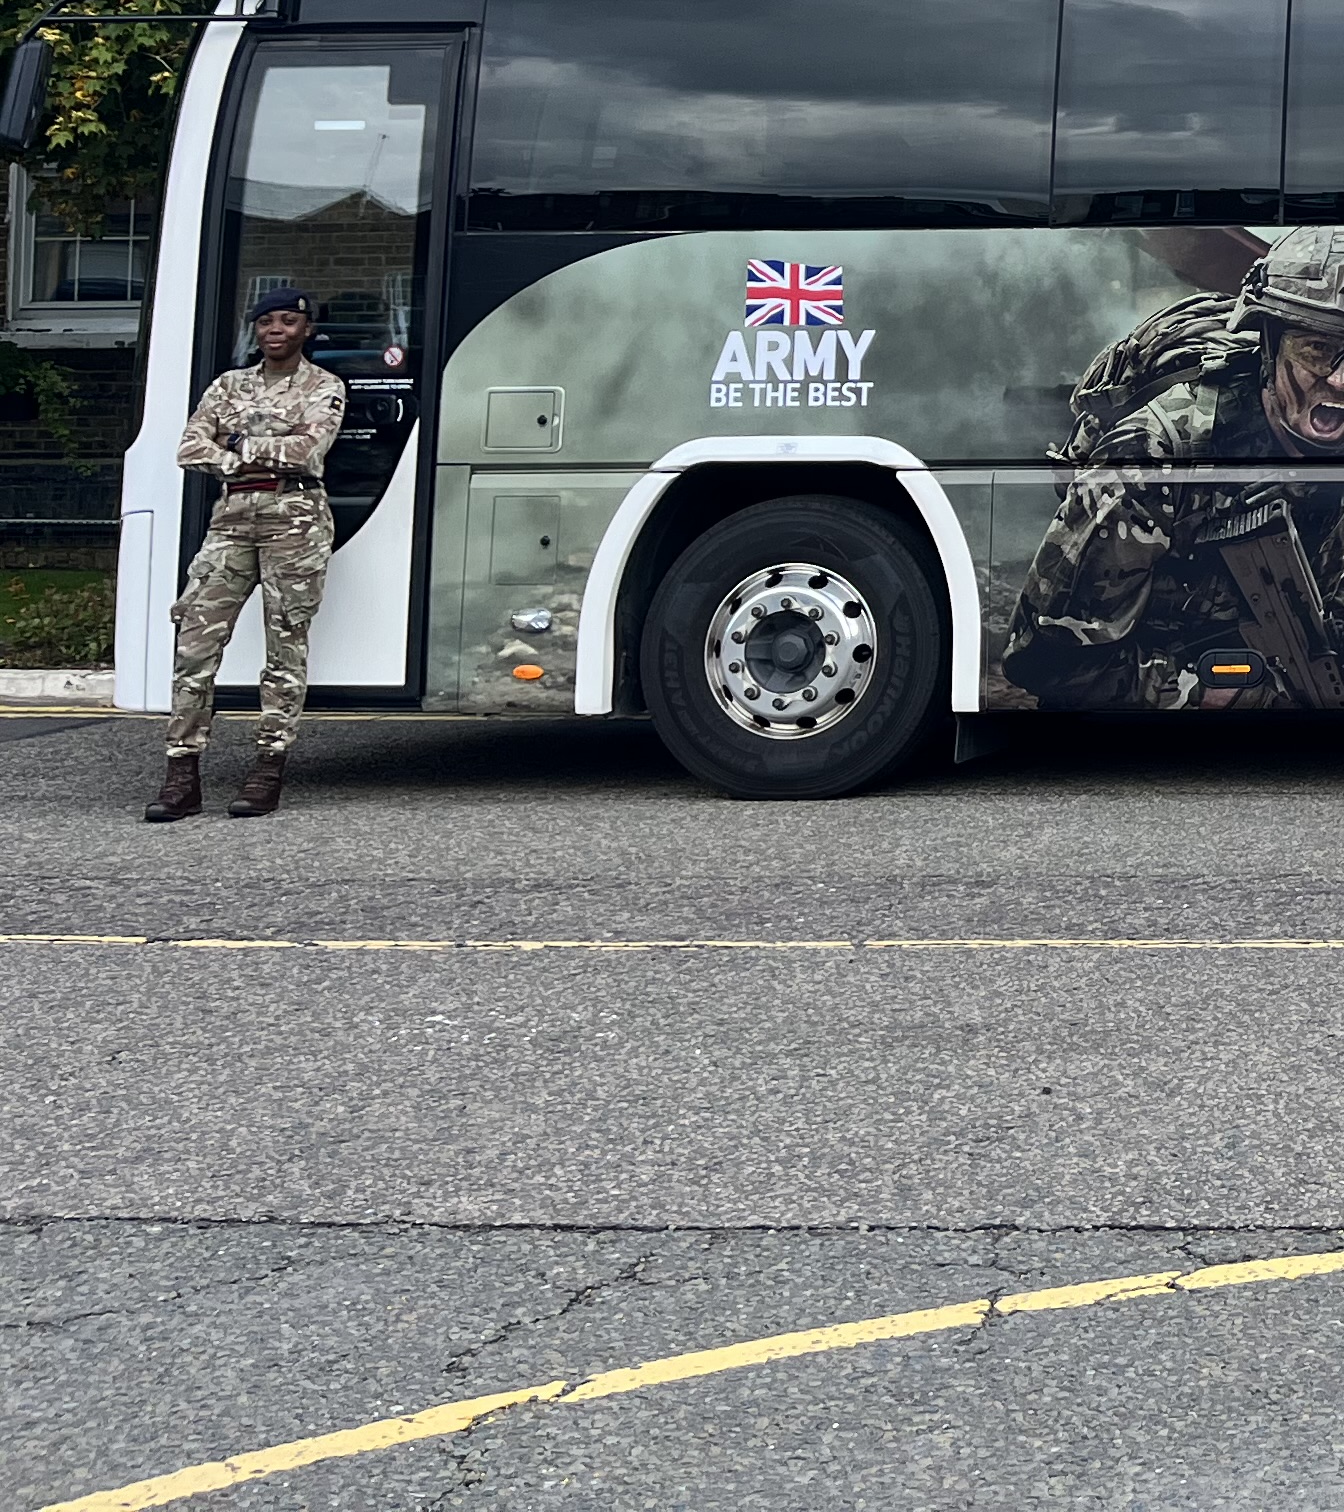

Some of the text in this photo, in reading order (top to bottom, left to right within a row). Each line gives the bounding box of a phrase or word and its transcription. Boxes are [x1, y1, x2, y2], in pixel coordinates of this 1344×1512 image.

[711, 330, 876, 381] ARMY
[710, 382, 875, 408] BE THE BEST
